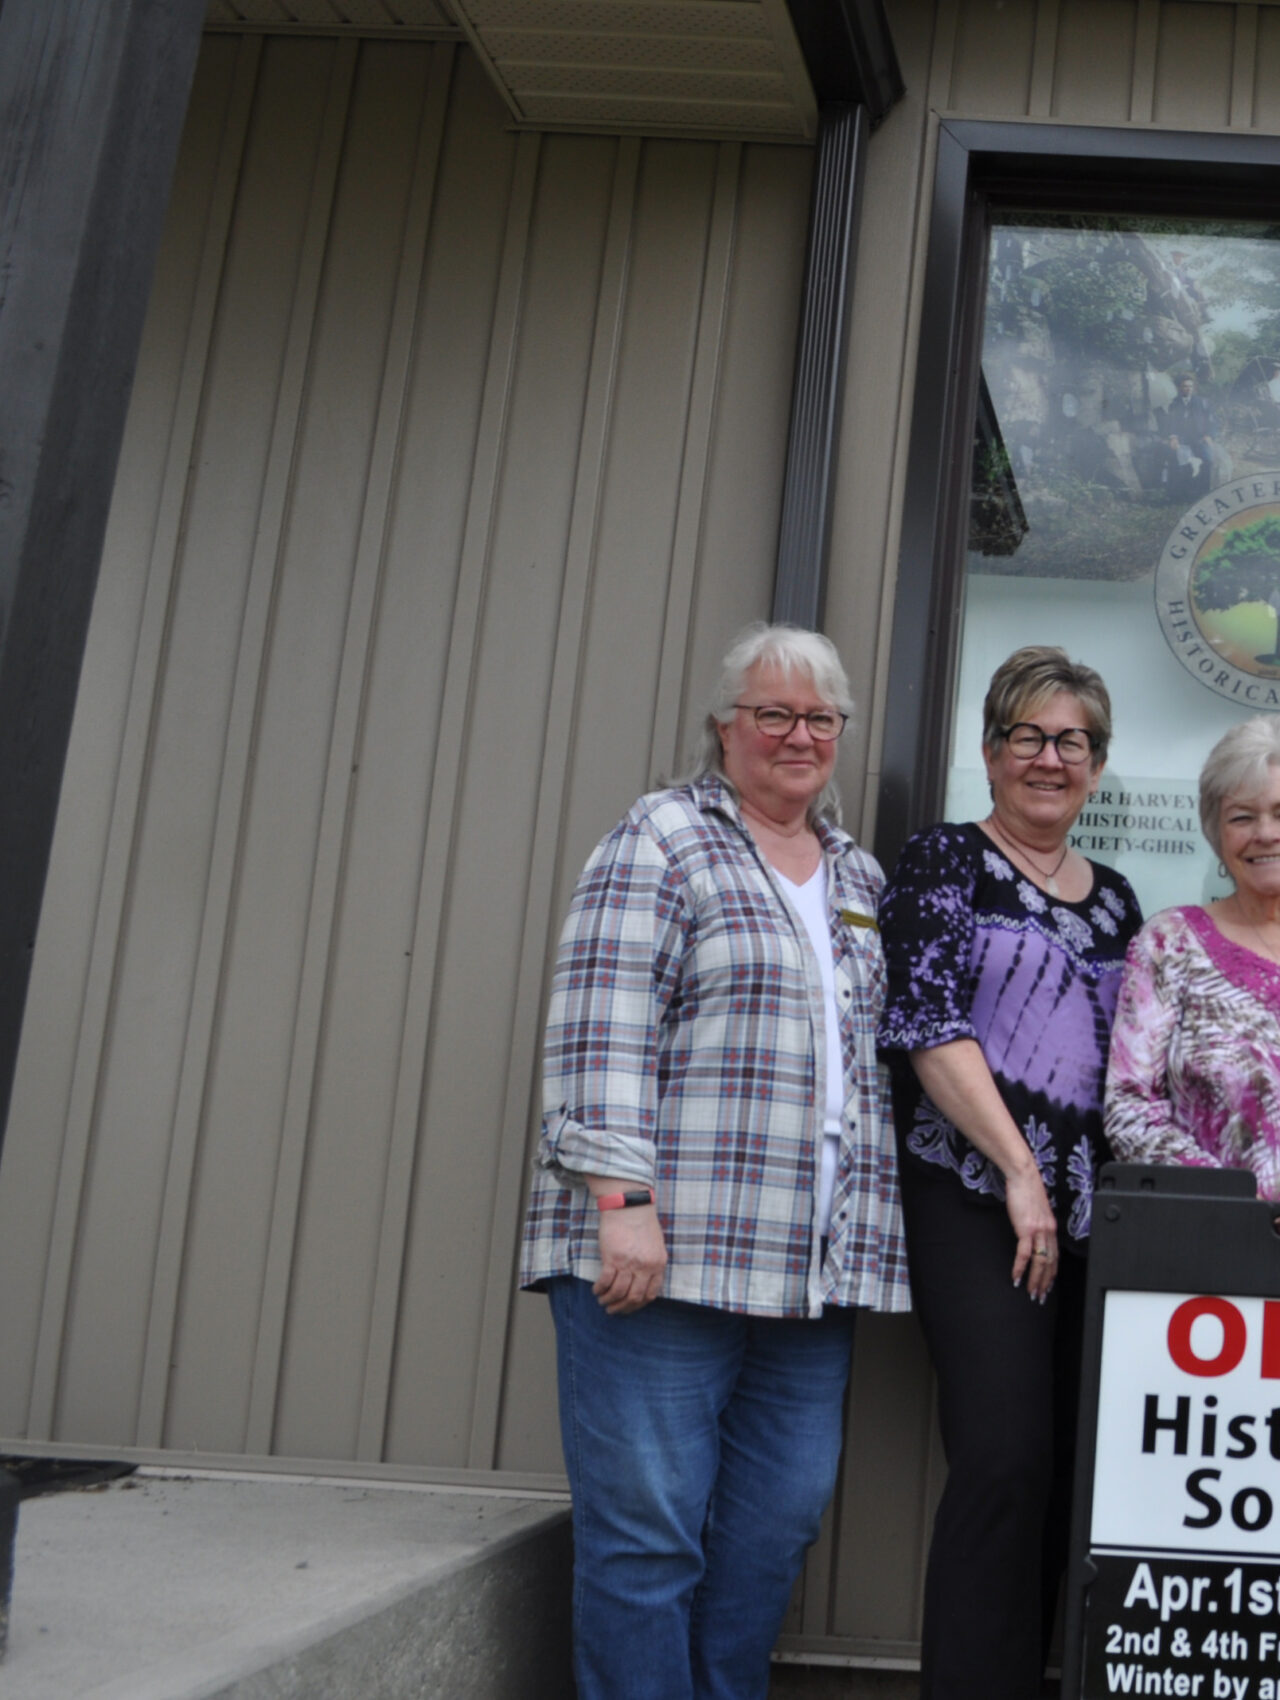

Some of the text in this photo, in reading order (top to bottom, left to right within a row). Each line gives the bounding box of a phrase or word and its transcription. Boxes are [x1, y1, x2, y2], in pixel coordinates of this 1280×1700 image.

[1119, 791, 1197, 809] HARVEY
[1078, 812, 1198, 833] HISTORICAL
[1065, 834, 1196, 855] OCIETY-GHHS
[1105, 1625, 1161, 1657] 2nd
[1170, 1628, 1192, 1658] &
[1201, 1630, 1249, 1661] 4th
[1106, 1663, 1204, 1697] Winter
[1213, 1669, 1249, 1700] by
